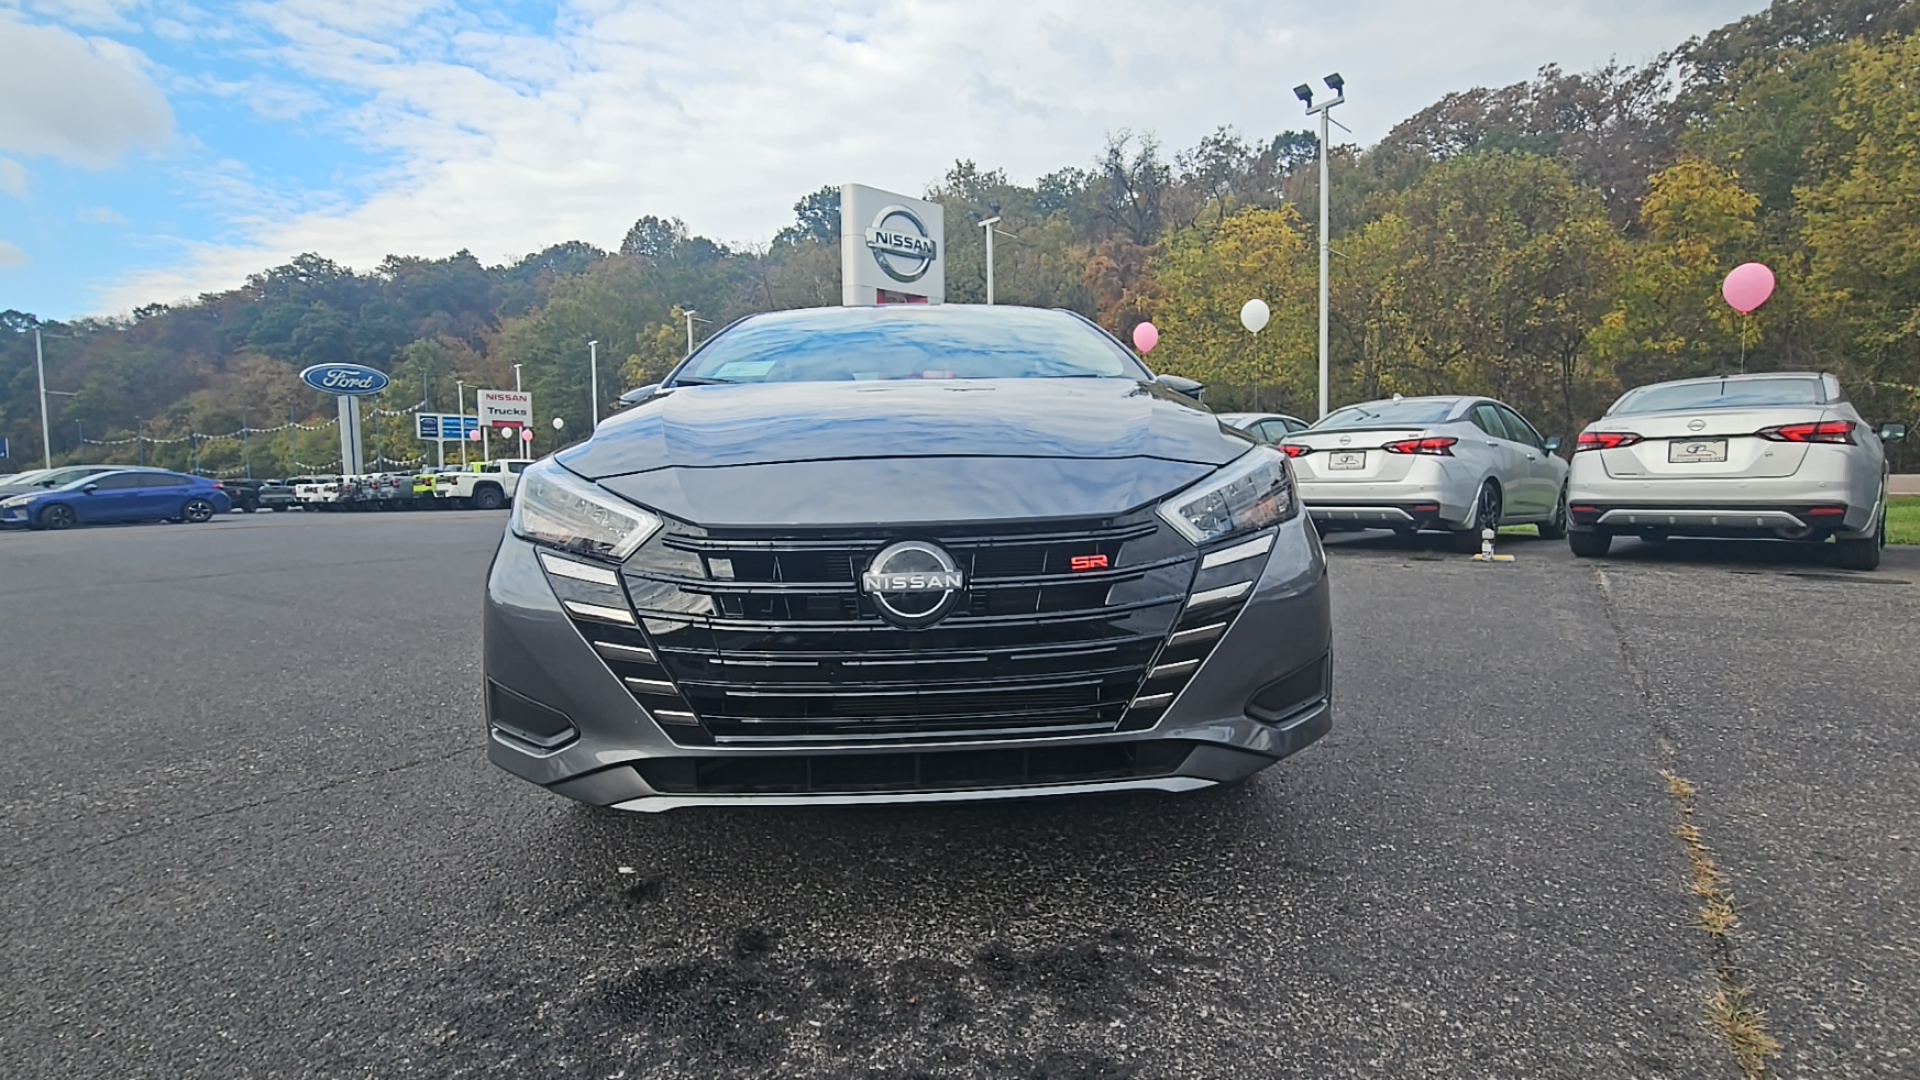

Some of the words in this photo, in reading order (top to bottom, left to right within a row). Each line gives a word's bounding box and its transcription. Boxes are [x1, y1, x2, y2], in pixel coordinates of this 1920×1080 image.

[875, 232, 932, 253] NISSAN
[323, 369, 374, 388] Ford
[485, 393, 528, 402] NISSAN
[487, 406, 527, 416] Trucks
[1071, 555, 1108, 571] SR
[864, 574, 962, 591] NISSAN
